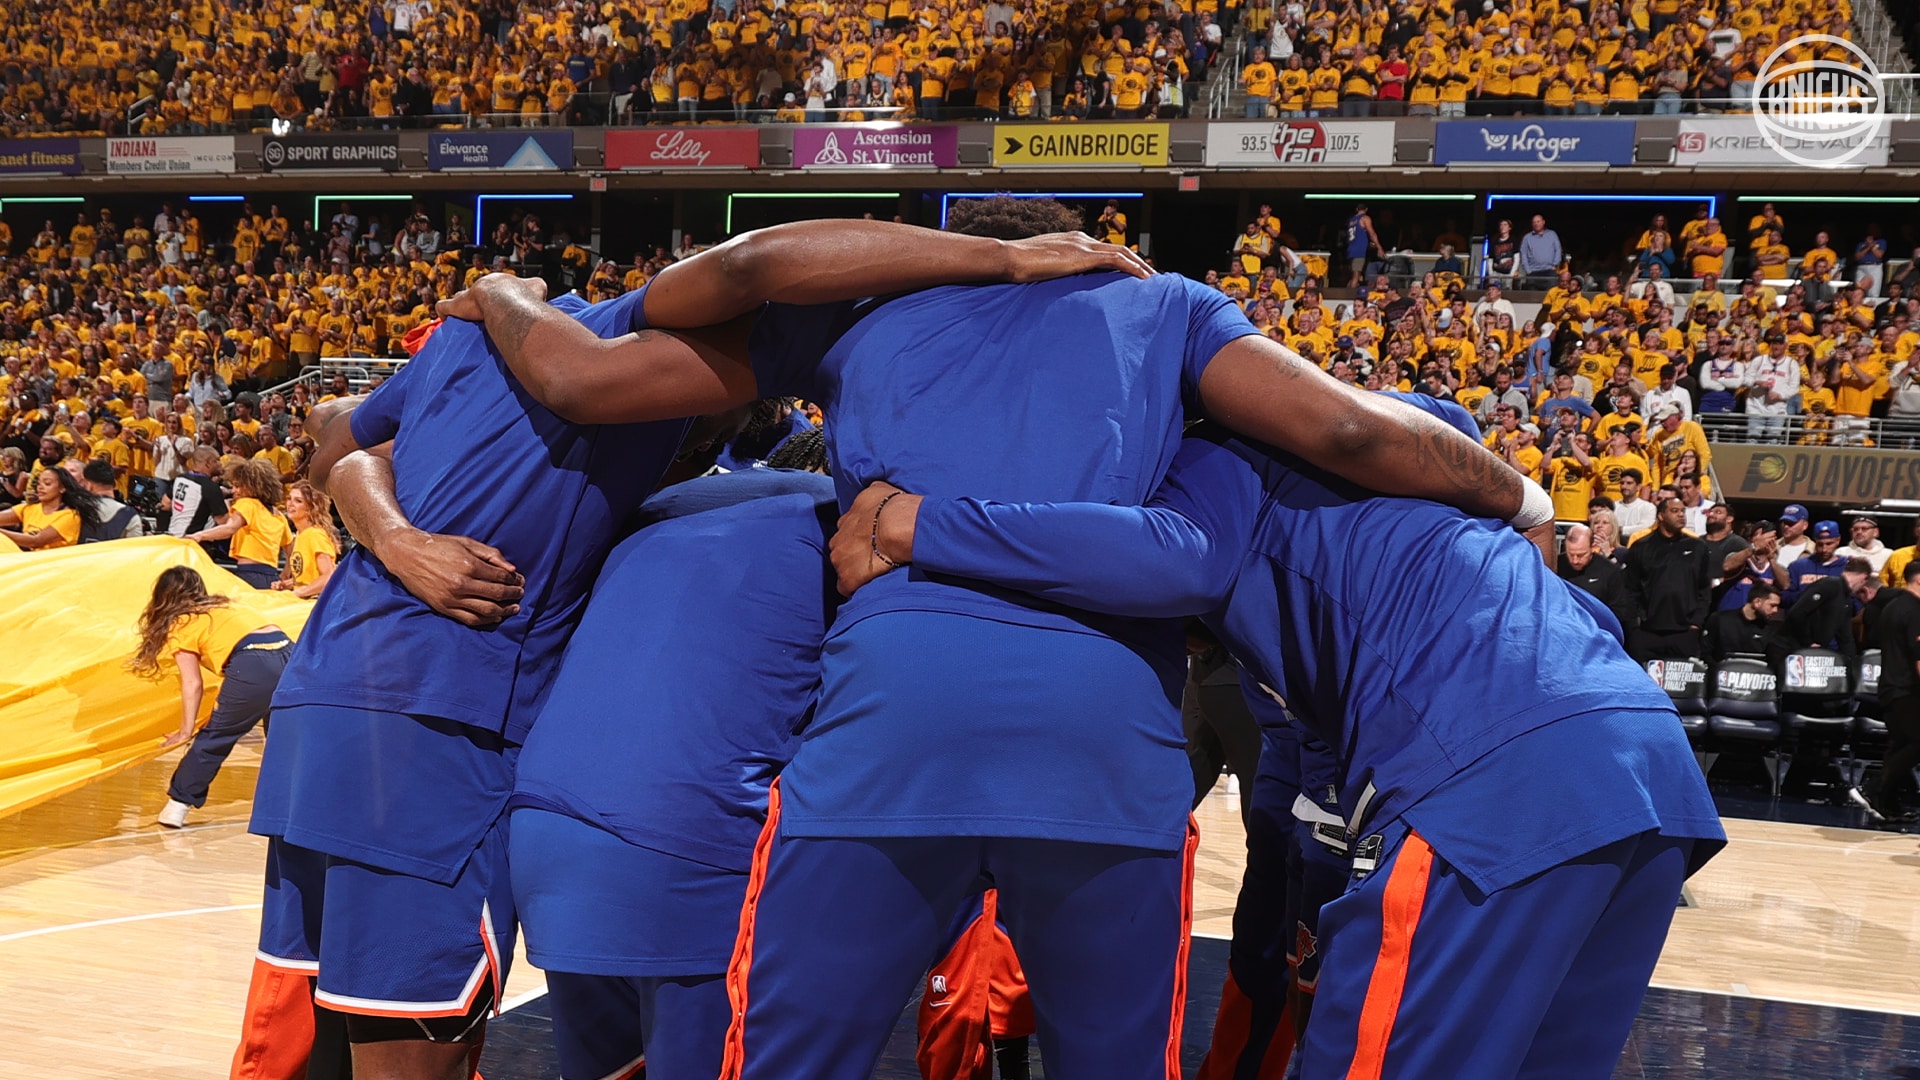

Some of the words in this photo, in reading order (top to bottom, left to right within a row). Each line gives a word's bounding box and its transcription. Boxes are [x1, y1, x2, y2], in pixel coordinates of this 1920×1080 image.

[853, 130, 932, 145] Ascension
[1270, 123, 1316, 145] the
[110, 140, 157, 157] INDIANA
[439, 143, 488, 155] Elevance
[650, 130, 711, 166] Lilly
[1029, 134, 1159, 156] GAINBRIDGE
[1241, 136, 1267, 151] 93.5
[1330, 135, 1360, 151] 107.5
[1512, 124, 1580, 162] Kroger
[0, 152, 28, 166] anet
[31, 151, 75, 165] fitness
[287, 146, 329, 160] SPORT
[332, 145, 397, 159] GRAPHICS
[462, 153, 488, 163] Health
[1279, 142, 1327, 163] fan
[109, 161, 142, 171] Members
[144, 160, 167, 171] Credit
[168, 160, 191, 170] Union
[1789, 453, 1920, 500] PLAYOFFS
[175, 482, 189, 502] 25
[1665, 661, 1694, 672] EASTERN
[1805, 656, 1835, 667] EASTERN
[1664, 672, 1706, 683] CONFERENCE
[1804, 666, 1847, 677] CONFERENCE
[1664, 681, 1687, 691] FINALS
[1727, 672, 1777, 690] PLAYOFFS
[1804, 677, 1828, 687] FINALS
